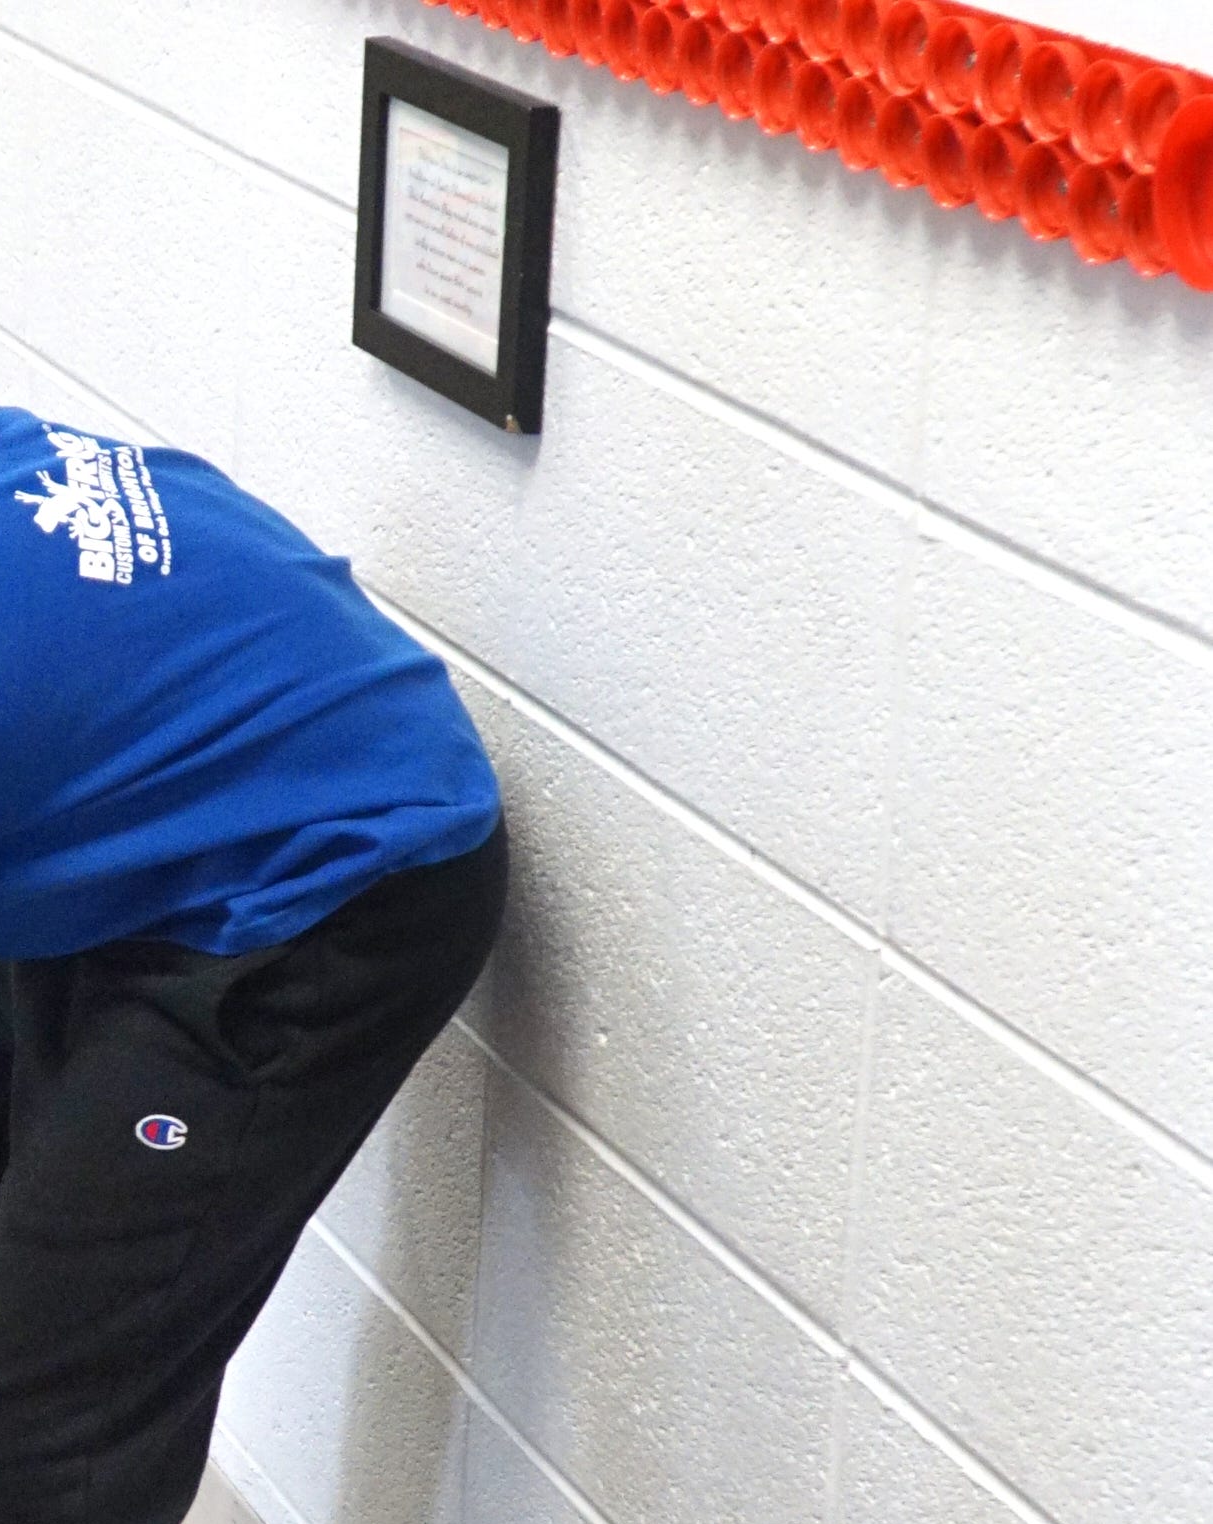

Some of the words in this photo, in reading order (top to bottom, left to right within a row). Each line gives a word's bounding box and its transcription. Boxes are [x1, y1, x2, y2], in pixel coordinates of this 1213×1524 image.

[76, 509, 115, 582] BIG
[112, 524, 133, 584] CUSTOM
[137, 533, 158, 563] OF
